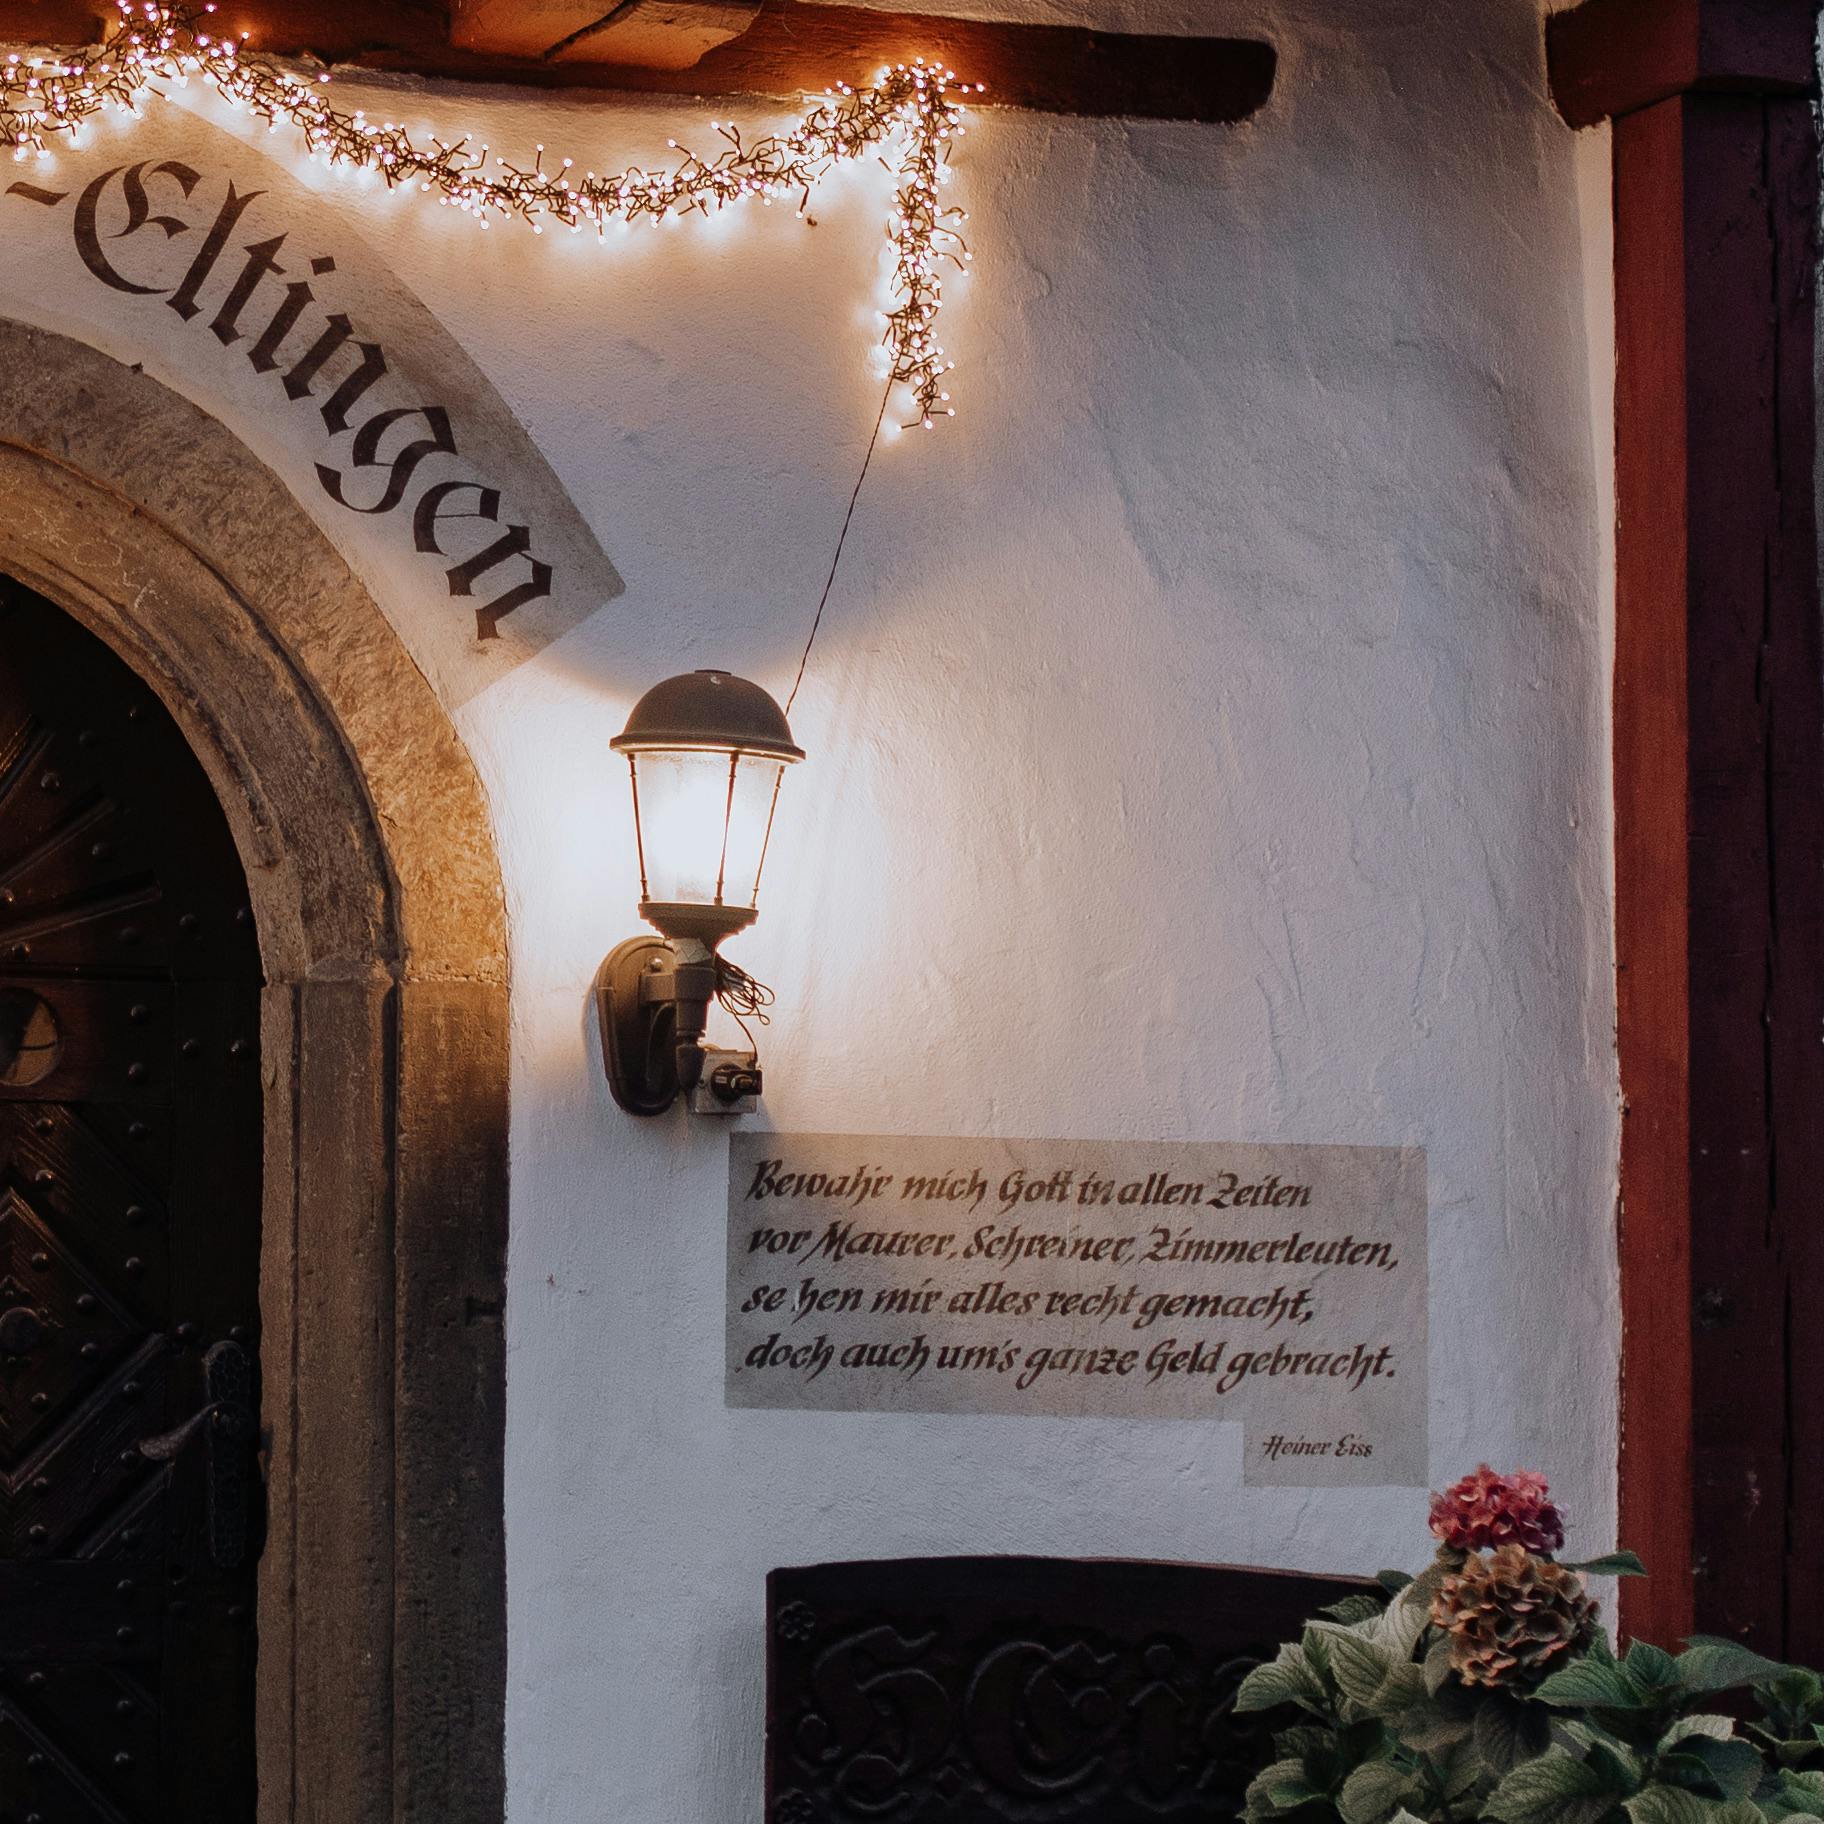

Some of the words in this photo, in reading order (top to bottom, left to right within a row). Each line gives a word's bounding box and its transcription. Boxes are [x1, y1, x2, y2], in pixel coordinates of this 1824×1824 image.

[745, 1160, 893, 1206] Bewahr
[902, 1168, 988, 1211] mich
[998, 1168, 1075, 1214] Gott
[1077, 1171, 1115, 1206] in
[1114, 1170, 1205, 1208] allen
[1206, 1168, 1313, 1210] Zeiten
[746, 1226, 812, 1257] vor
[798, 1219, 960, 1267] Maurer,
[962, 1225, 1137, 1272] Schreiner,
[1140, 1225, 1401, 1273] Zimmerleuten,
[868, 1278, 943, 1317] mir
[947, 1279, 1040, 1318] alles
[1043, 1281, 1137, 1324] recht
[1135, 1284, 1316, 1331] gemacht,
[744, 1332, 835, 1383] doch
[839, 1333, 933, 1382] auch
[1021, 1343, 1139, 1391] ganze
[1143, 1336, 1222, 1386] Geld
[1219, 1339, 1398, 1394] gebracht.
[1260, 1433, 1331, 1464] Heiner
